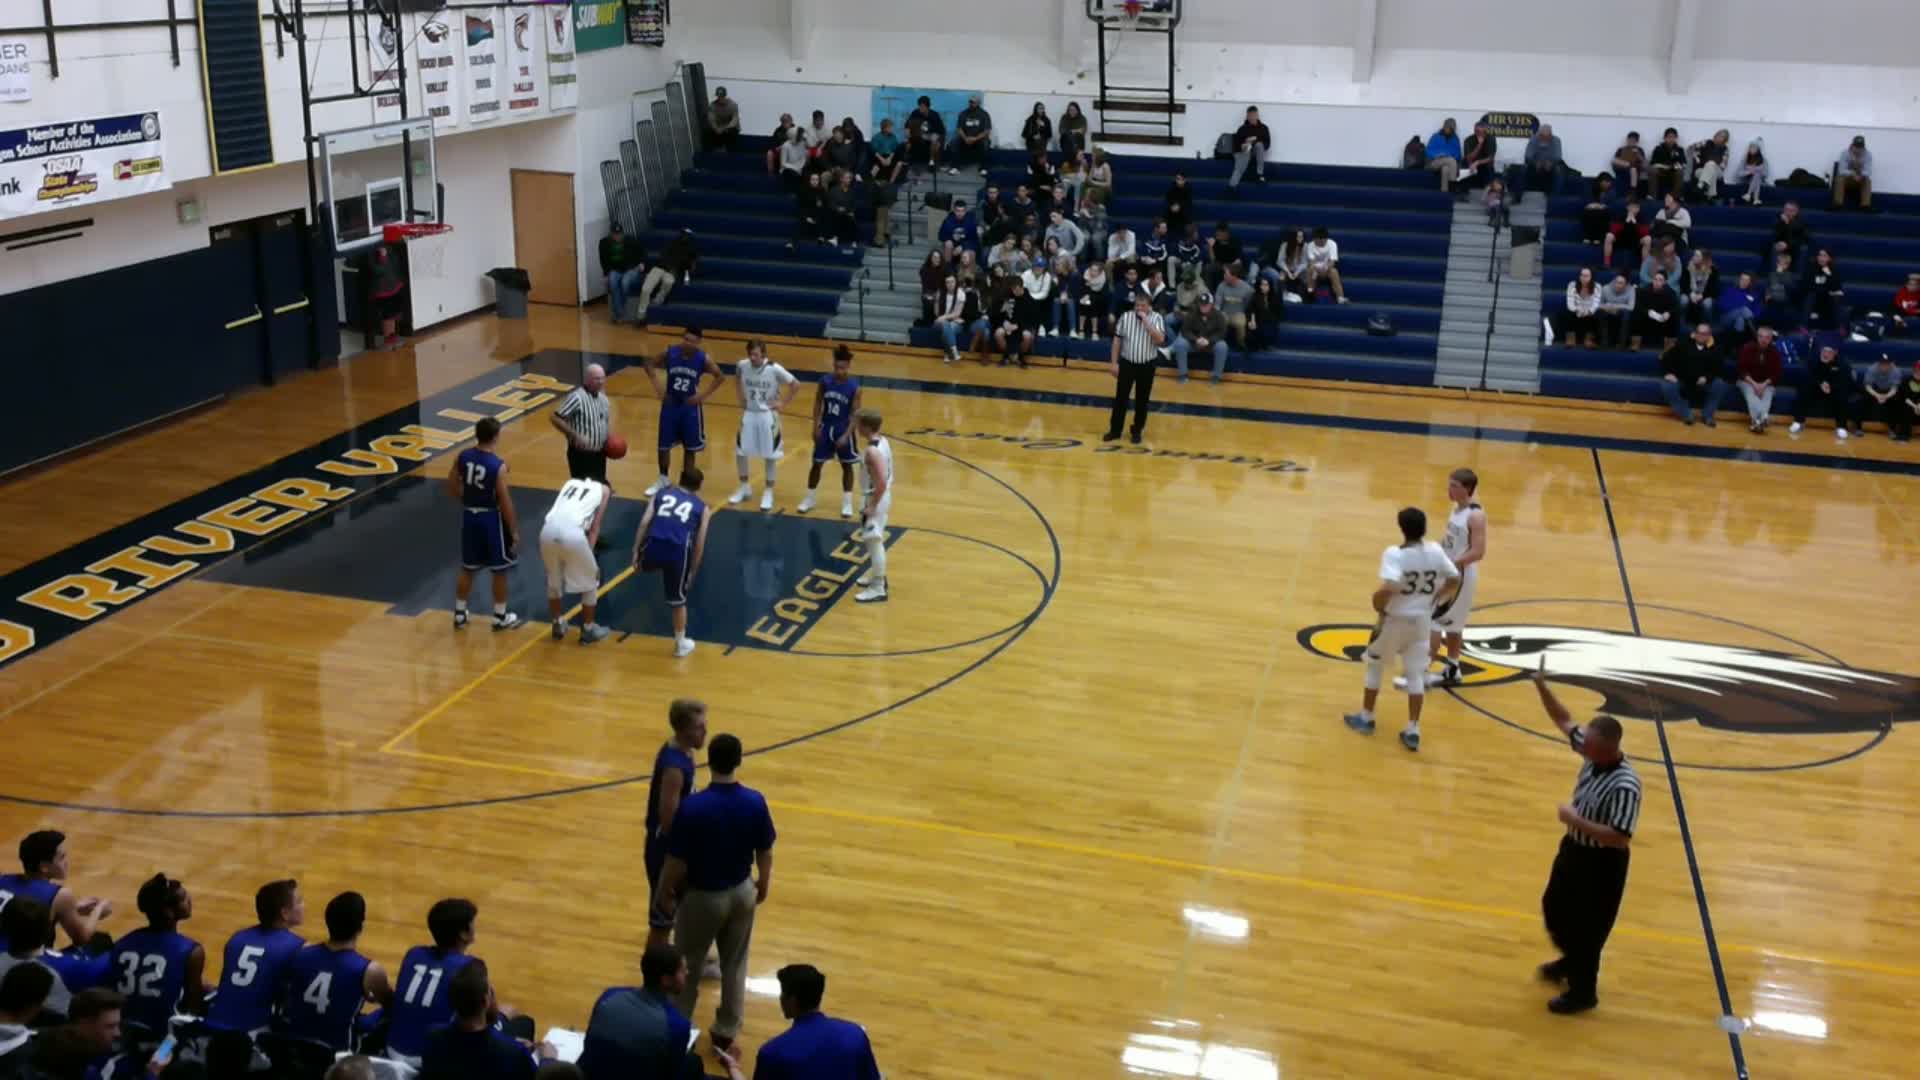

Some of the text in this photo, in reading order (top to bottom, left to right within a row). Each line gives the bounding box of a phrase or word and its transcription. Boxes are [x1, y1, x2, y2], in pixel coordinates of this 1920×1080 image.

[0, 43, 28, 60] ER
[16, 141, 48, 158] School
[94, 129, 143, 147] Association
[27, 122, 95, 142] Member of the
[0, 177, 22, 196] nk
[673, 377, 691, 391] 22
[465, 461, 487, 490] 12
[16, 477, 356, 621] RIVER
[315, 372, 575, 476] VALLEY
[656, 494, 694, 524] 24
[1401, 570, 1437, 594] 33
[117, 950, 168, 998] 32
[231, 945, 266, 988] 5
[303, 971, 335, 1015] 4
[403, 963, 445, 1008] 11
